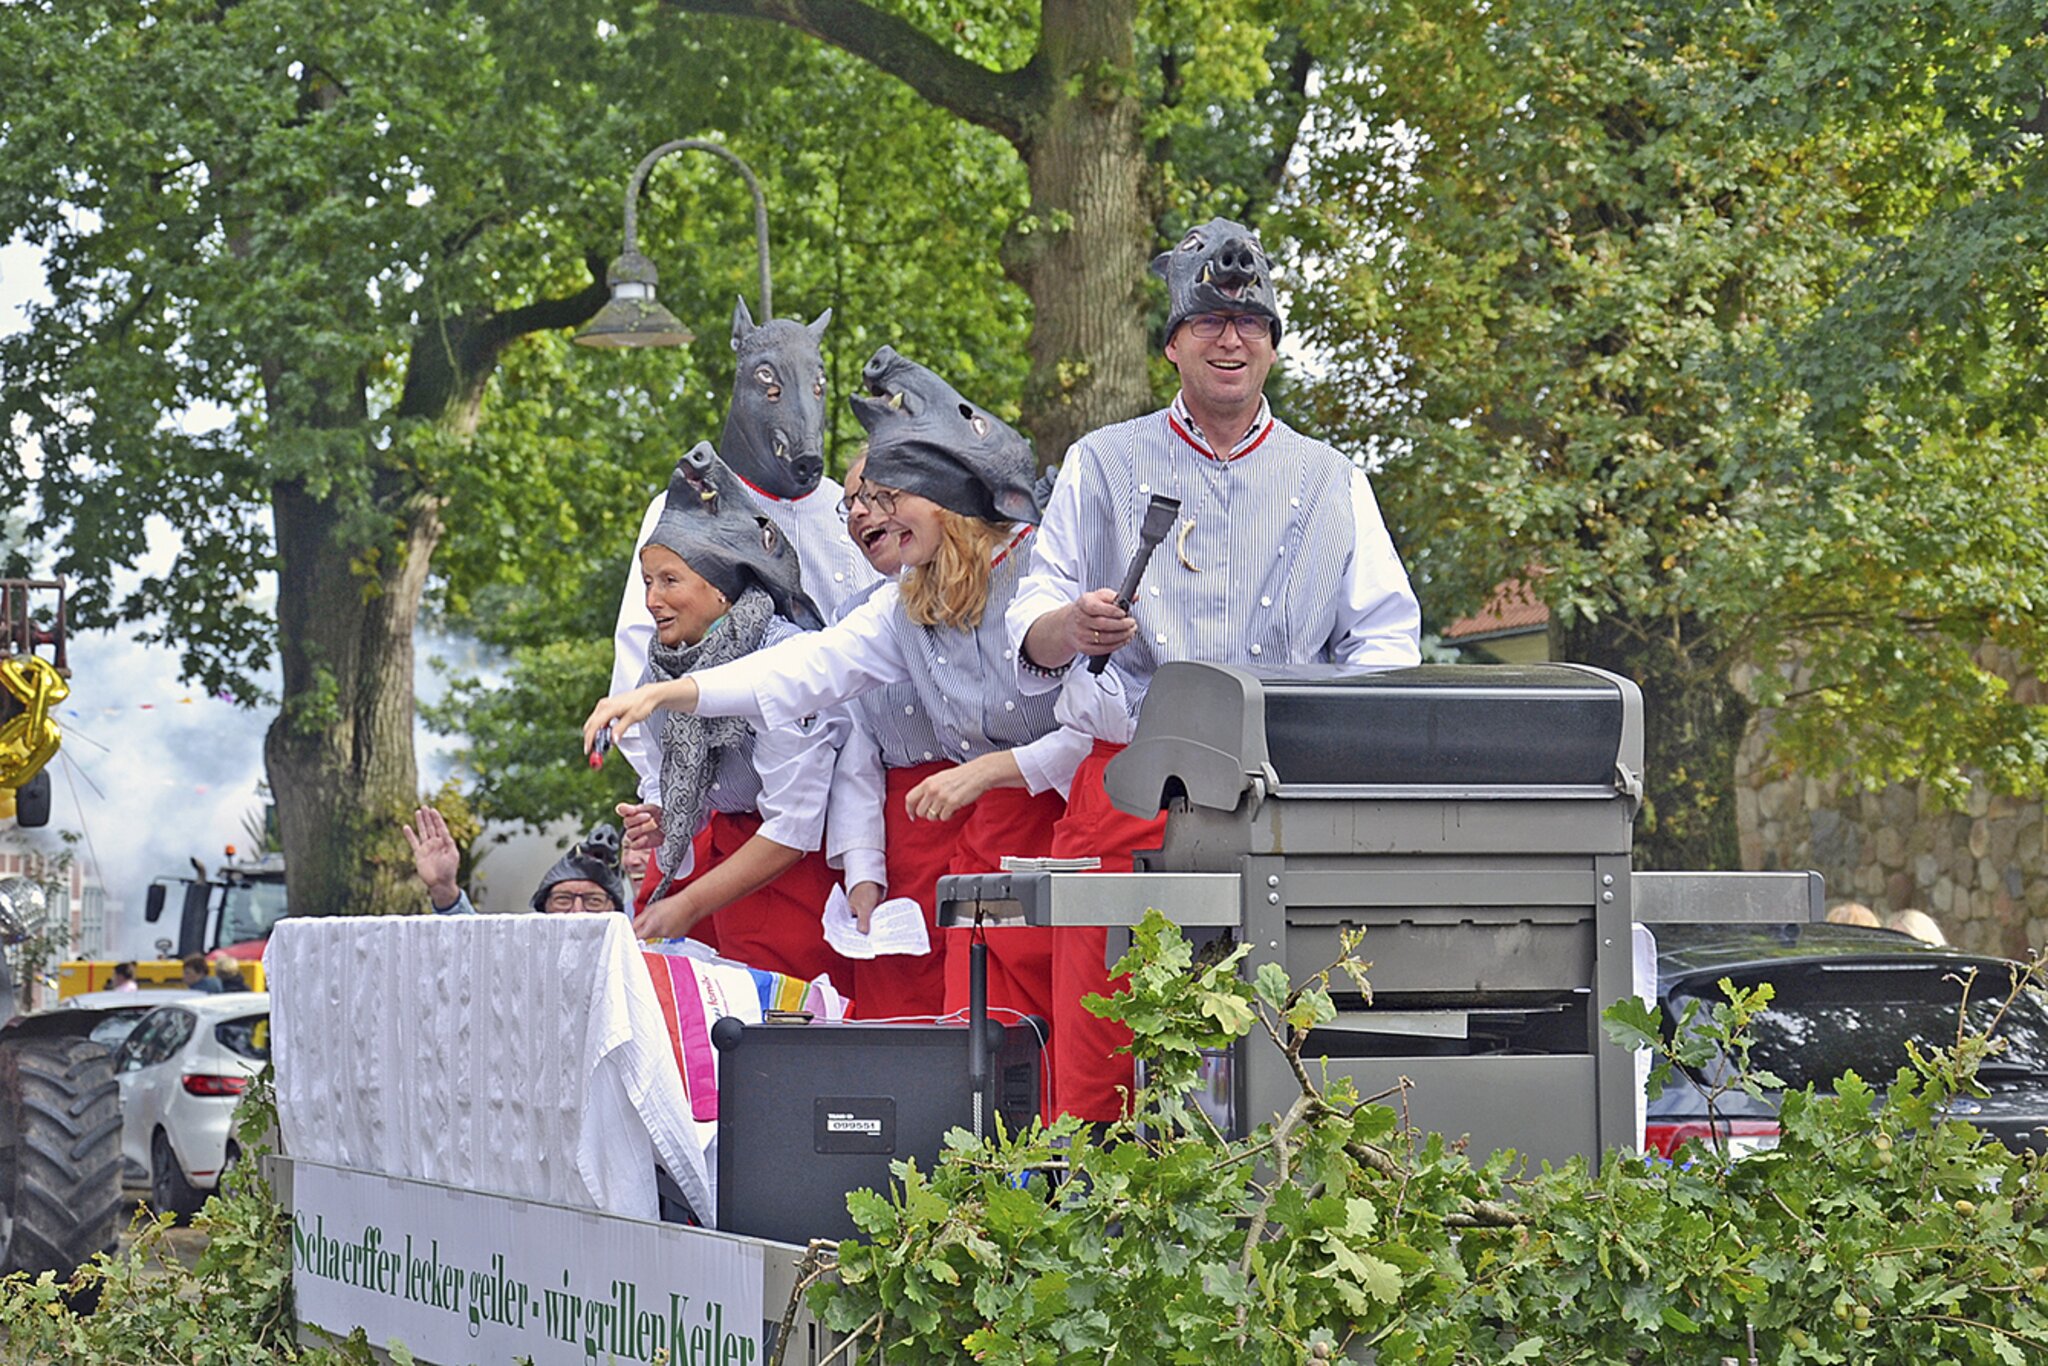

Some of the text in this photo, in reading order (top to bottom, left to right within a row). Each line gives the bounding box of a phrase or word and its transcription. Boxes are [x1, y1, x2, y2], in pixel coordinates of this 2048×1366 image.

[294, 1209, 401, 1296] Schaerffer
[404, 1234, 464, 1313] lecker
[468, 1252, 528, 1338] geiler
[543, 1269, 582, 1344] wir
[584, 1279, 666, 1366] grillen
[669, 1292, 755, 1366] Keiler
